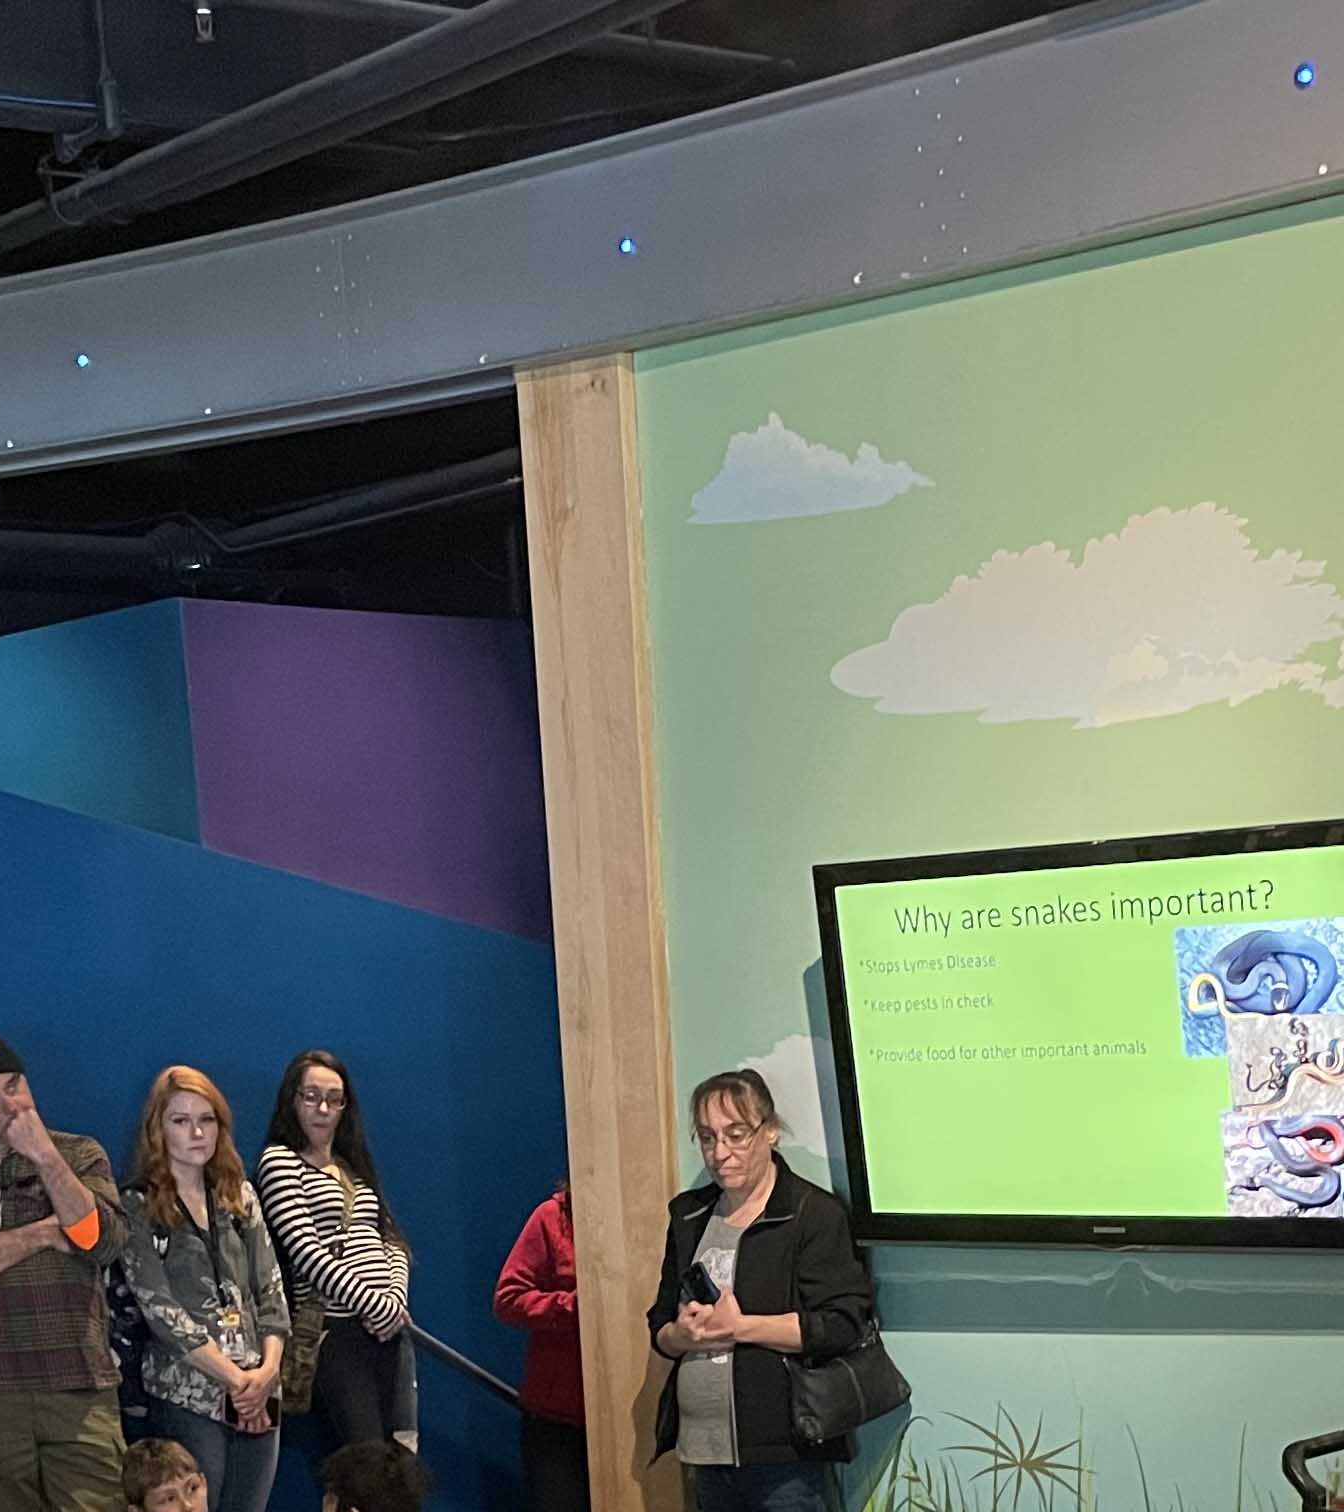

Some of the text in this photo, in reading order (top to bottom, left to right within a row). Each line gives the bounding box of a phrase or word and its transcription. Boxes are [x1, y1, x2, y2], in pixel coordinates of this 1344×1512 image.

[894, 879, 1275, 939] Why are snakes important?
[865, 954, 997, 975] Stops Lymes Disease
[870, 993, 994, 1015] Keep pests in check
[876, 1040, 1147, 1063] Provide food for other important animals
